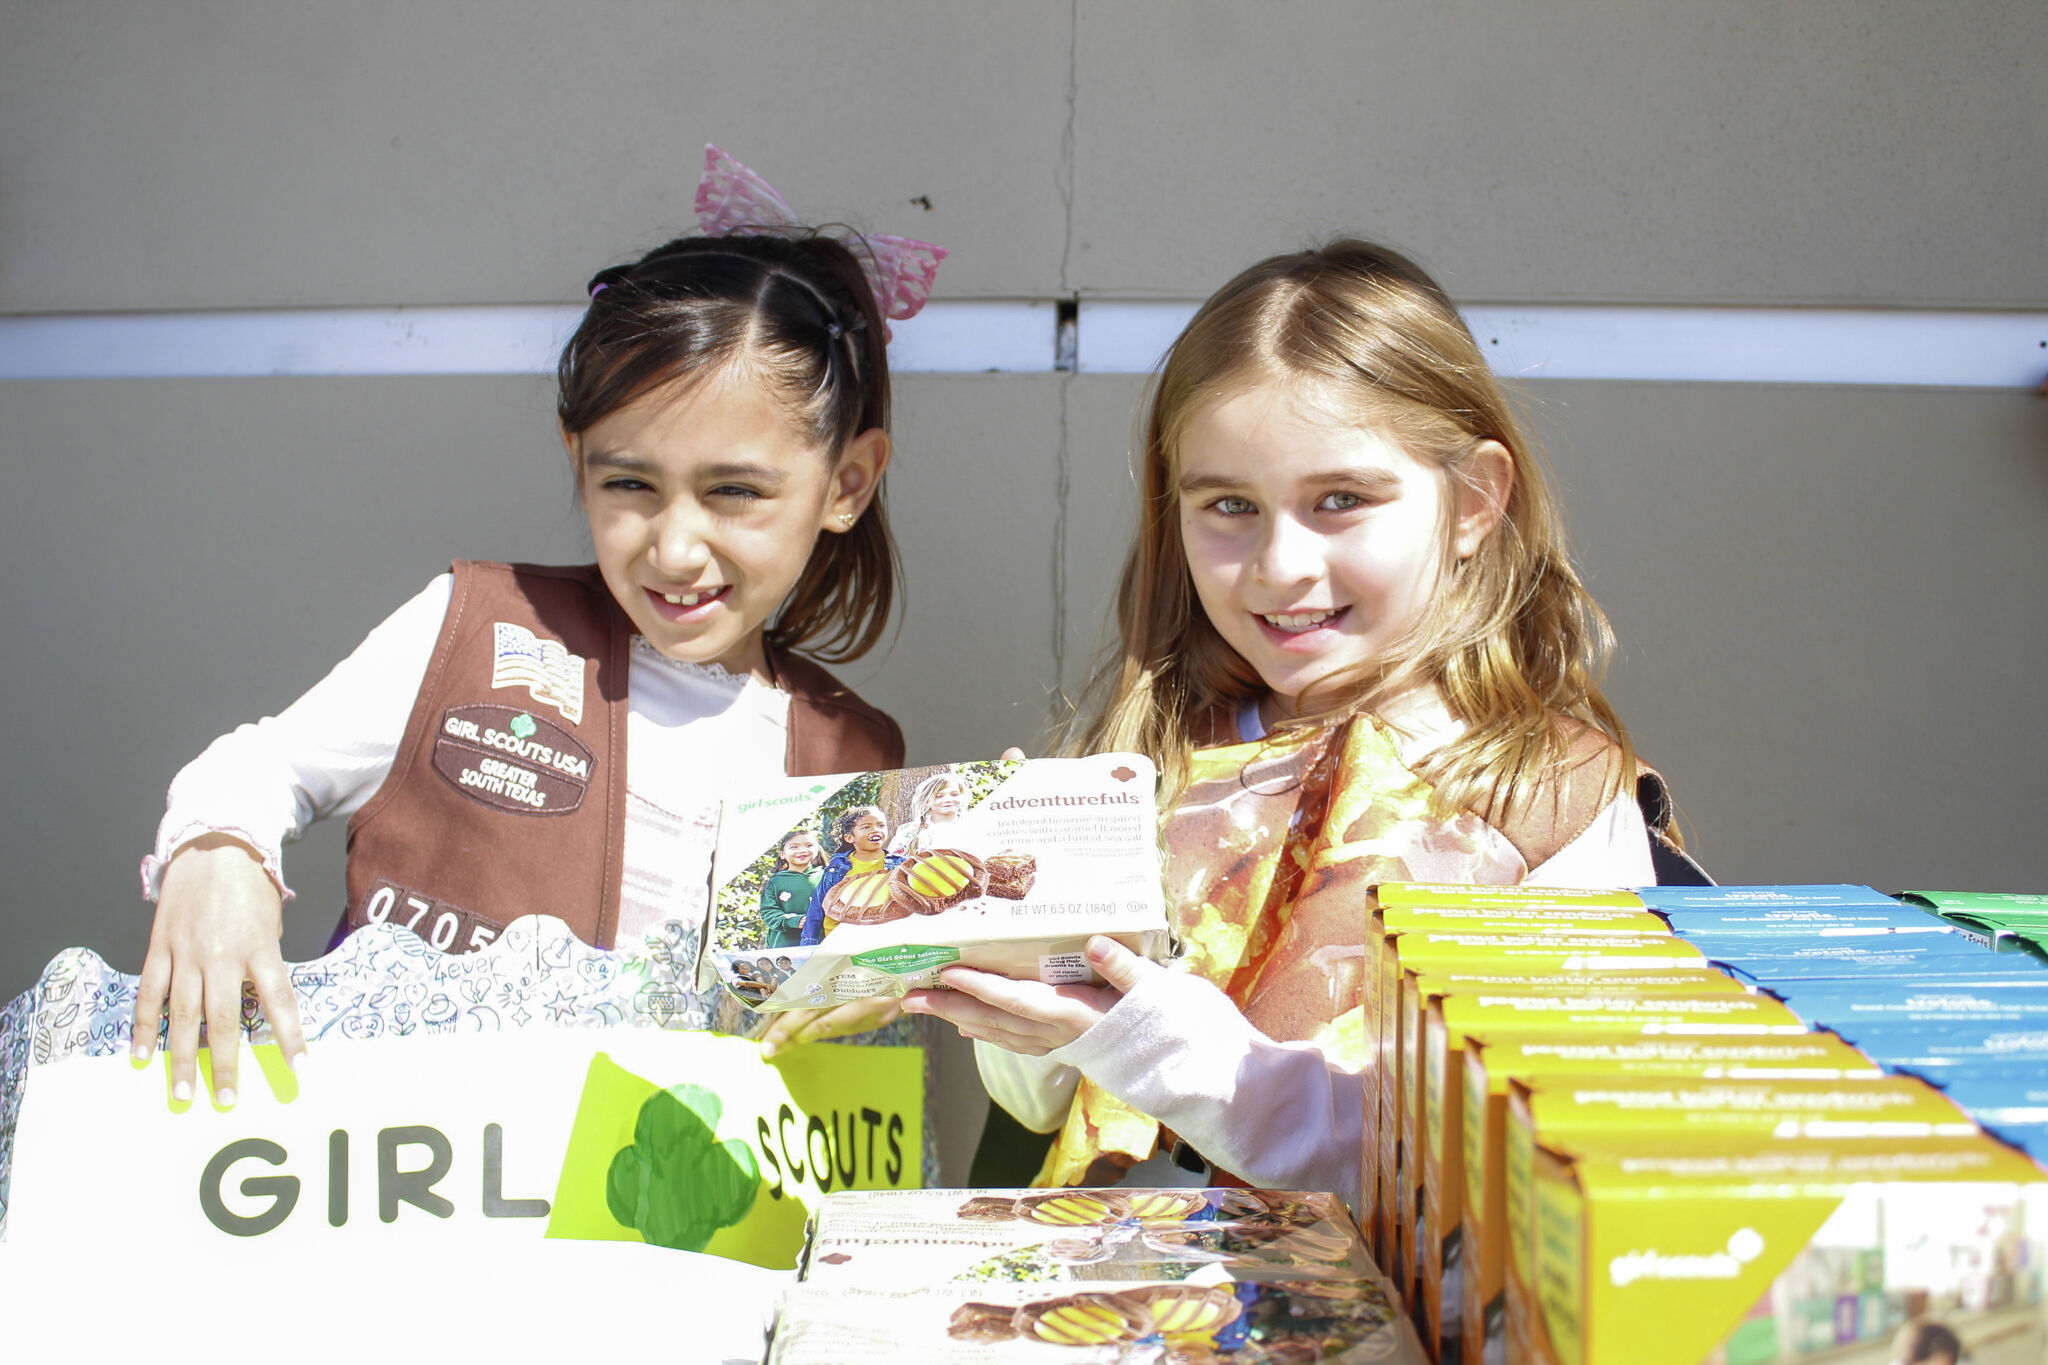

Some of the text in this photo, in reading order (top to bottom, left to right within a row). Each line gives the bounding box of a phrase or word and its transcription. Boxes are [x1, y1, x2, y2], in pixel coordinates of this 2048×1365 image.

[445, 717, 588, 778] GIRL SCOUTS USA
[458, 768, 547, 808] SOUTH TEXAS
[480, 758, 538, 789] GREATER
[989, 791, 1141, 812] adventurefuls
[1011, 902, 1117, 916] NET WT 6.5 OZ (184g)
[829, 974, 856, 982] STEM
[199, 1103, 904, 1238] GIRL SCOUTS
